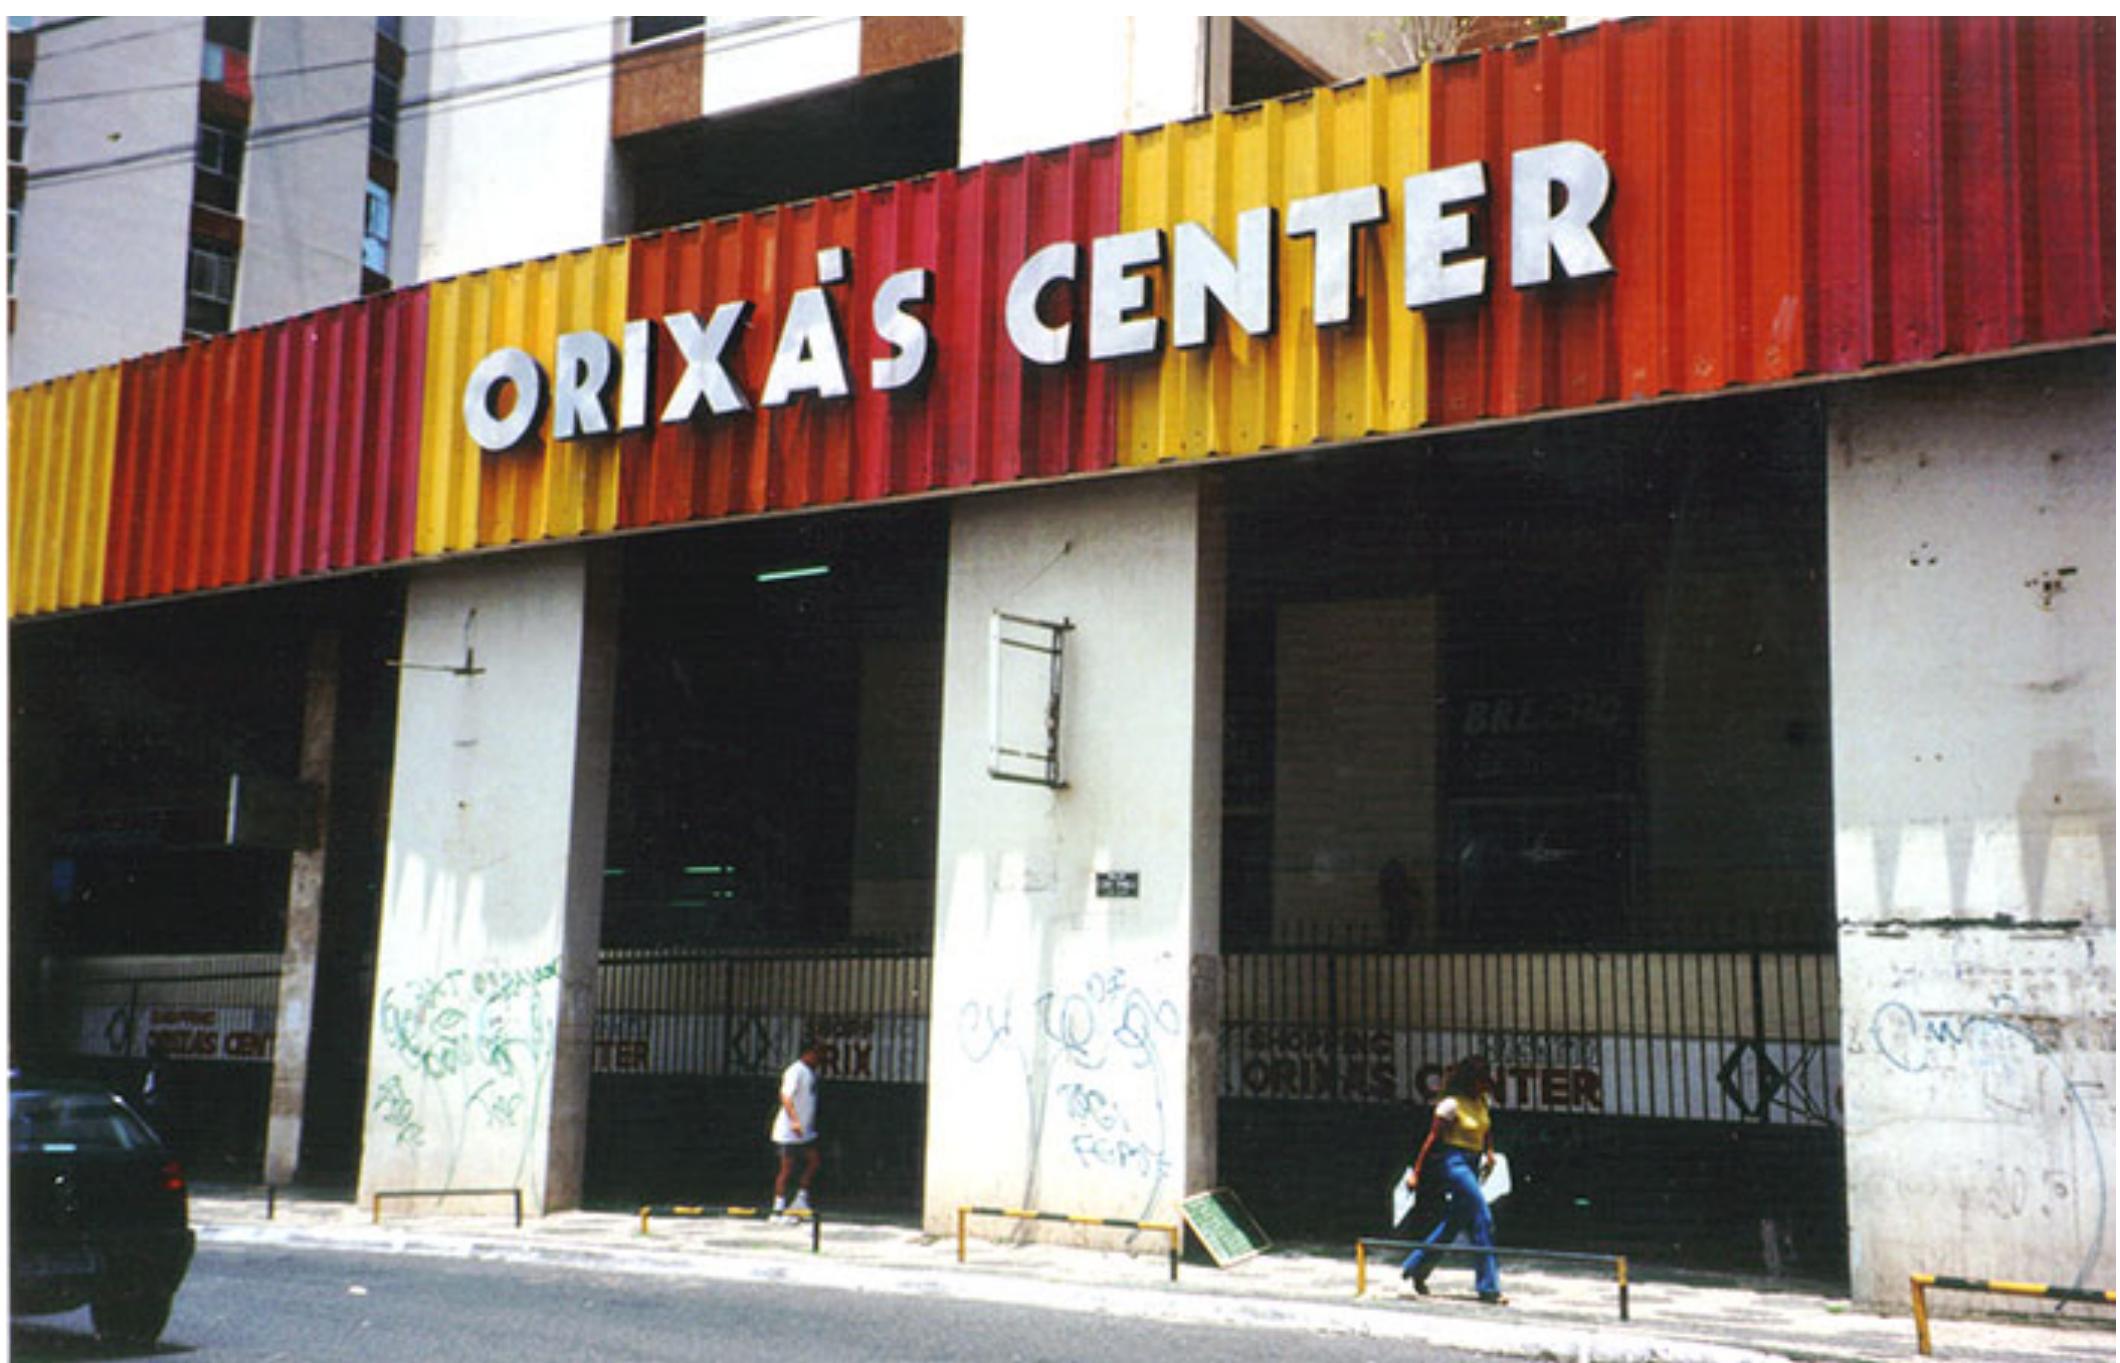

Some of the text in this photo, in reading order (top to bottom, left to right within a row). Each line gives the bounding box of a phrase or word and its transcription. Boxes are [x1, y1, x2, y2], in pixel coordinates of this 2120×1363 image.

[461, 139, 1614, 455] ORIXÁS CENTER
[816, 1043, 872, 1077] RIX
